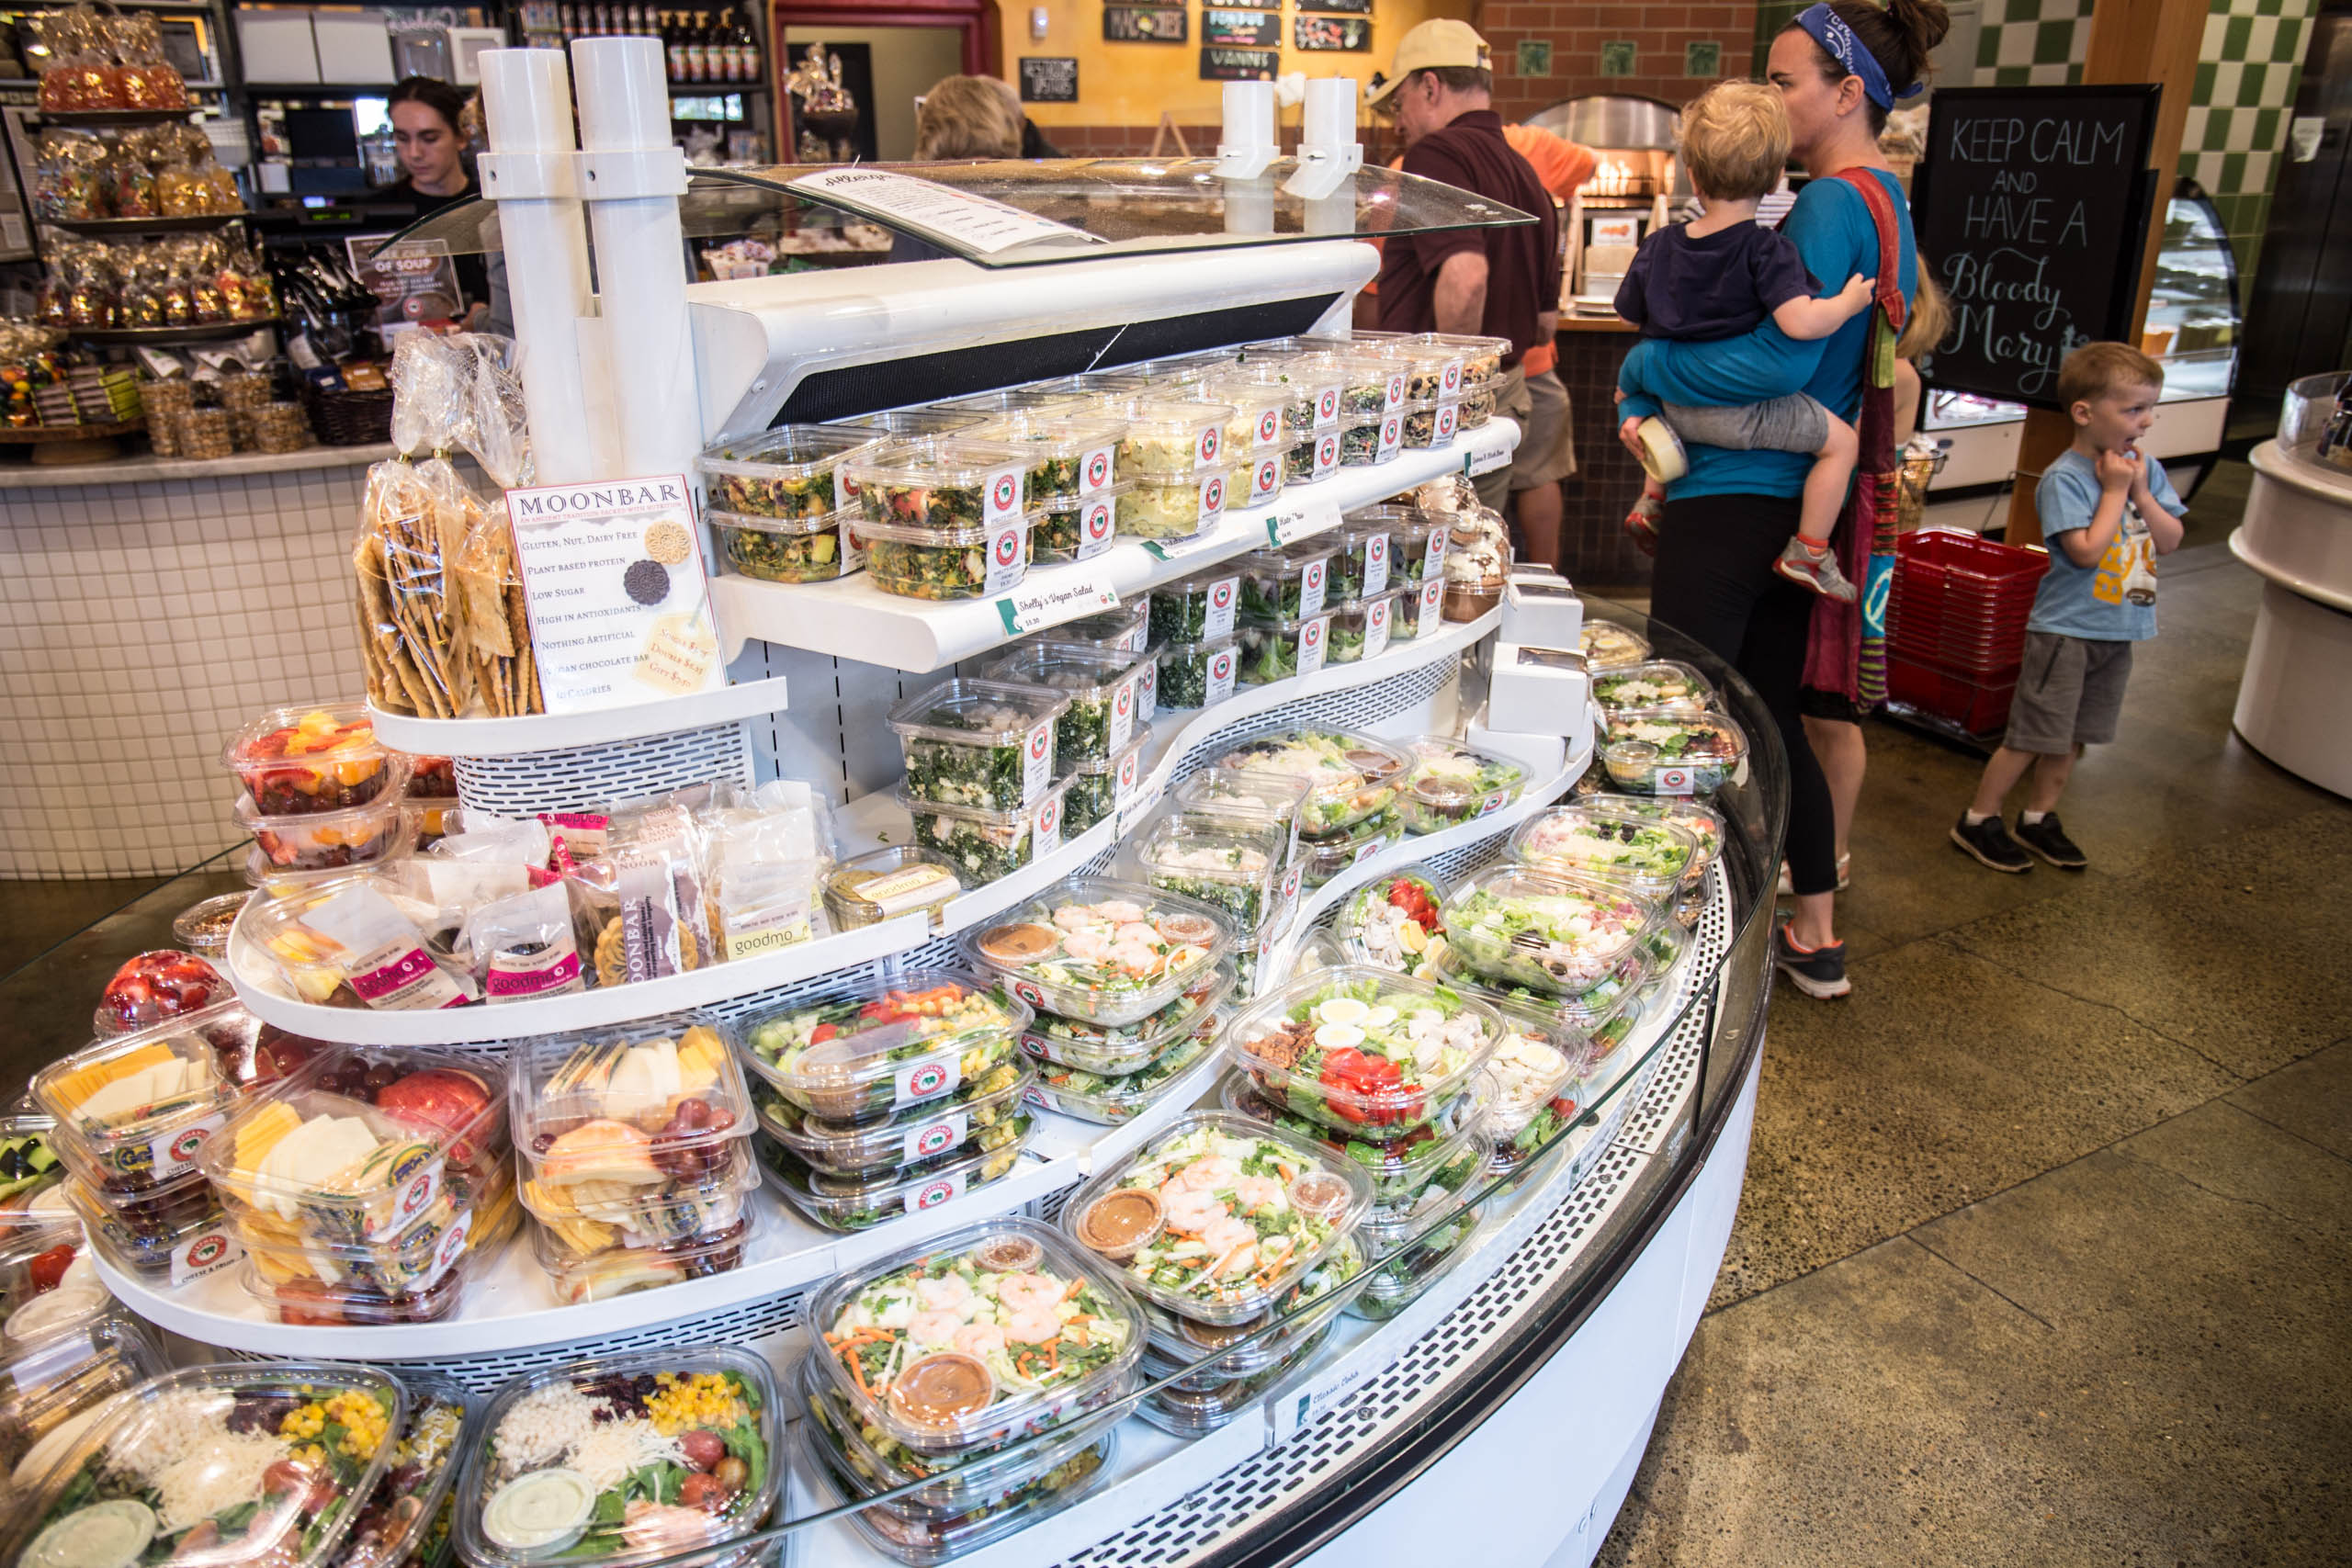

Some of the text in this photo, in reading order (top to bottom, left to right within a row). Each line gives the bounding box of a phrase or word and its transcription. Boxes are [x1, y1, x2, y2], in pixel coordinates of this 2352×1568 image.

[1950, 118, 2125, 165] KEEP CALM
[1991, 170, 2038, 194] AND
[1964, 195, 2087, 248] HAVE A
[375, 257, 432, 273] OF SOUP
[1942, 247, 2072, 331] Bloody
[1939, 304, 2064, 394] Mary
[520, 484, 681, 515] MOONBAR
[522, 540, 561, 551] GLUTEN,
[587, 535, 614, 544] DAIRY
[616, 532, 639, 540] FREE
[527, 557, 626, 575] PLANT BASED PROTEIN
[532, 587, 585, 601] LOW SUGAR
[1019, 583, 1094, 612] Shelly's Vegan Salad
[537, 604, 642, 626] HIGH IN ANTIOXIDANTS
[541, 630, 636, 650] NOTHING ARTIFICIAL
[579, 656, 631, 671] CHOCOLATE
[633, 653, 650, 662] BAR
[624, 897, 645, 984] OONBAR
[492, 964, 572, 993] goodmoon
[182, 1269, 207, 1283] CHEESE
